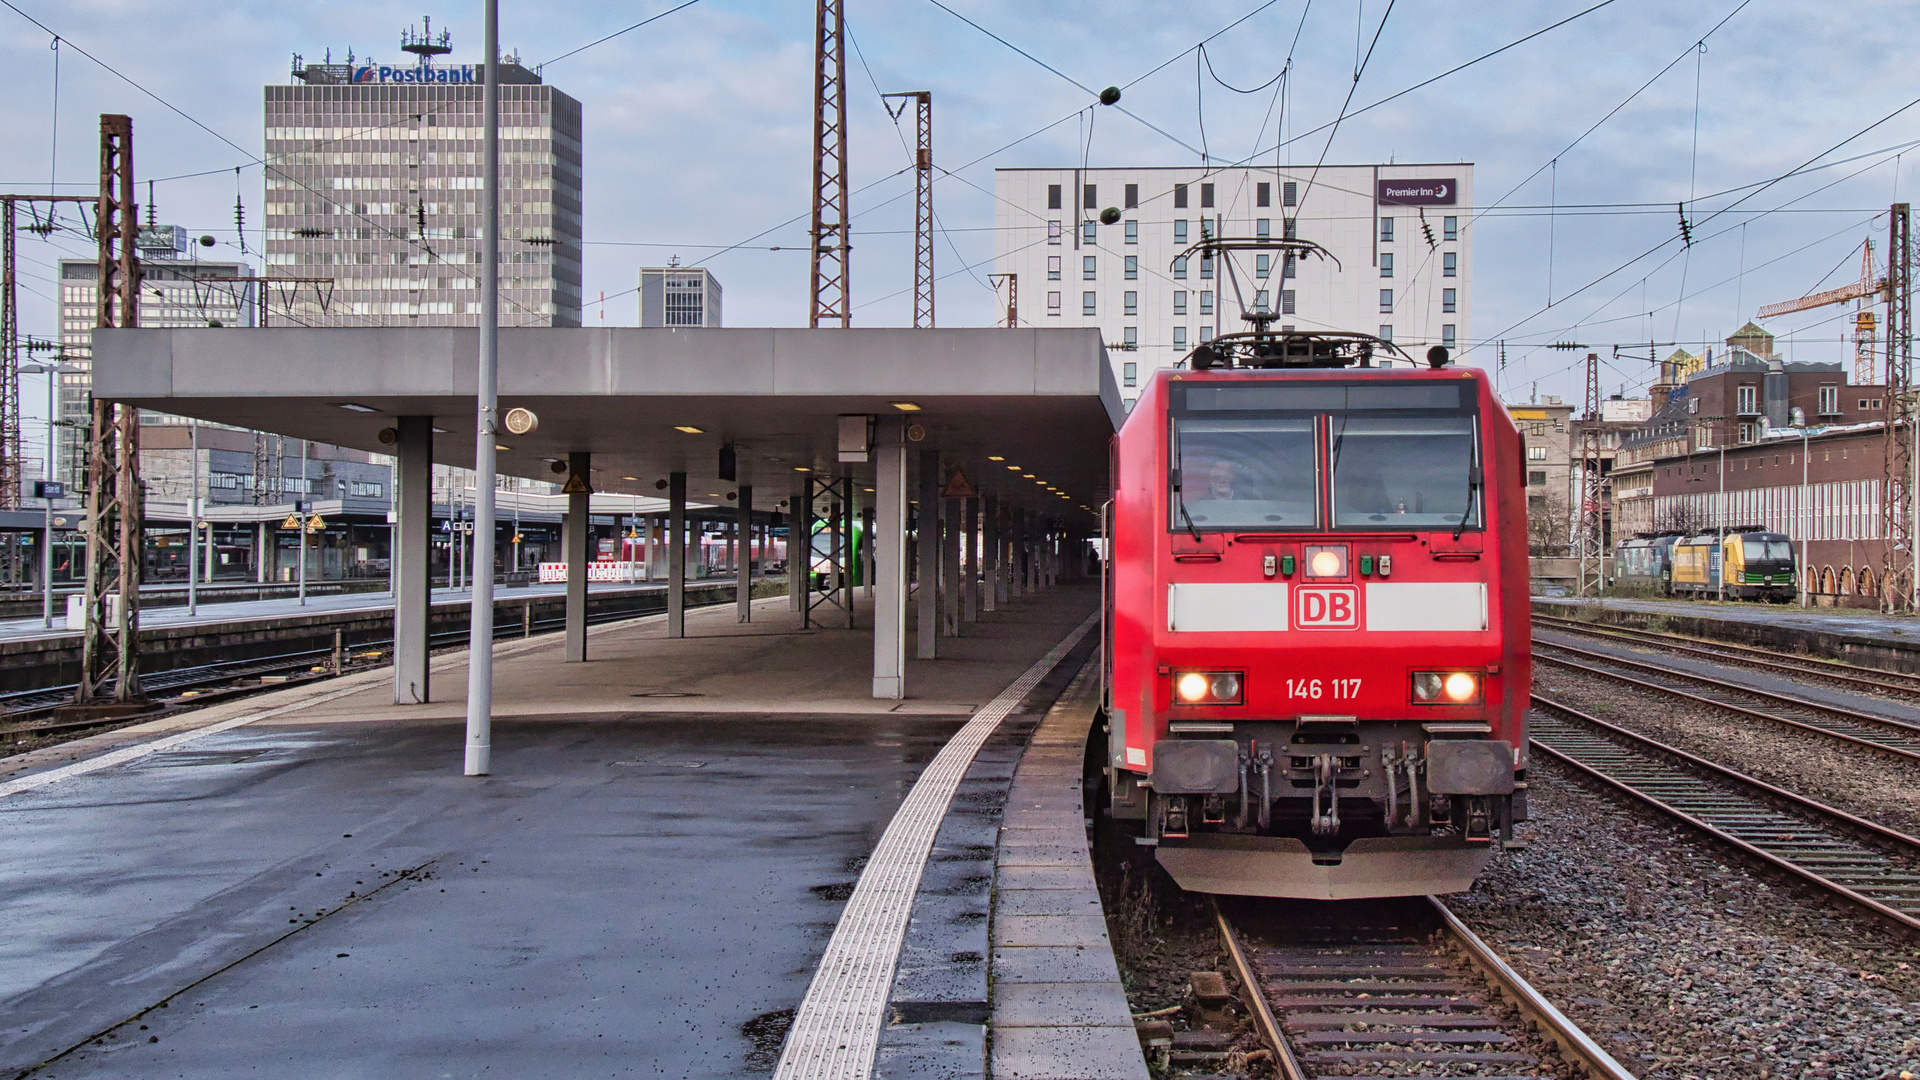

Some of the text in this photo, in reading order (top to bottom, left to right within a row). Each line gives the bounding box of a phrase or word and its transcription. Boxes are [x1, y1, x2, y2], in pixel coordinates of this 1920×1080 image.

[379, 64, 475, 82] Postbank
[1386, 187, 1434, 197] Premier Inn
[442, 520, 451, 531] A
[1303, 592, 1352, 622] DB
[1286, 679, 1362, 699] 146 117
